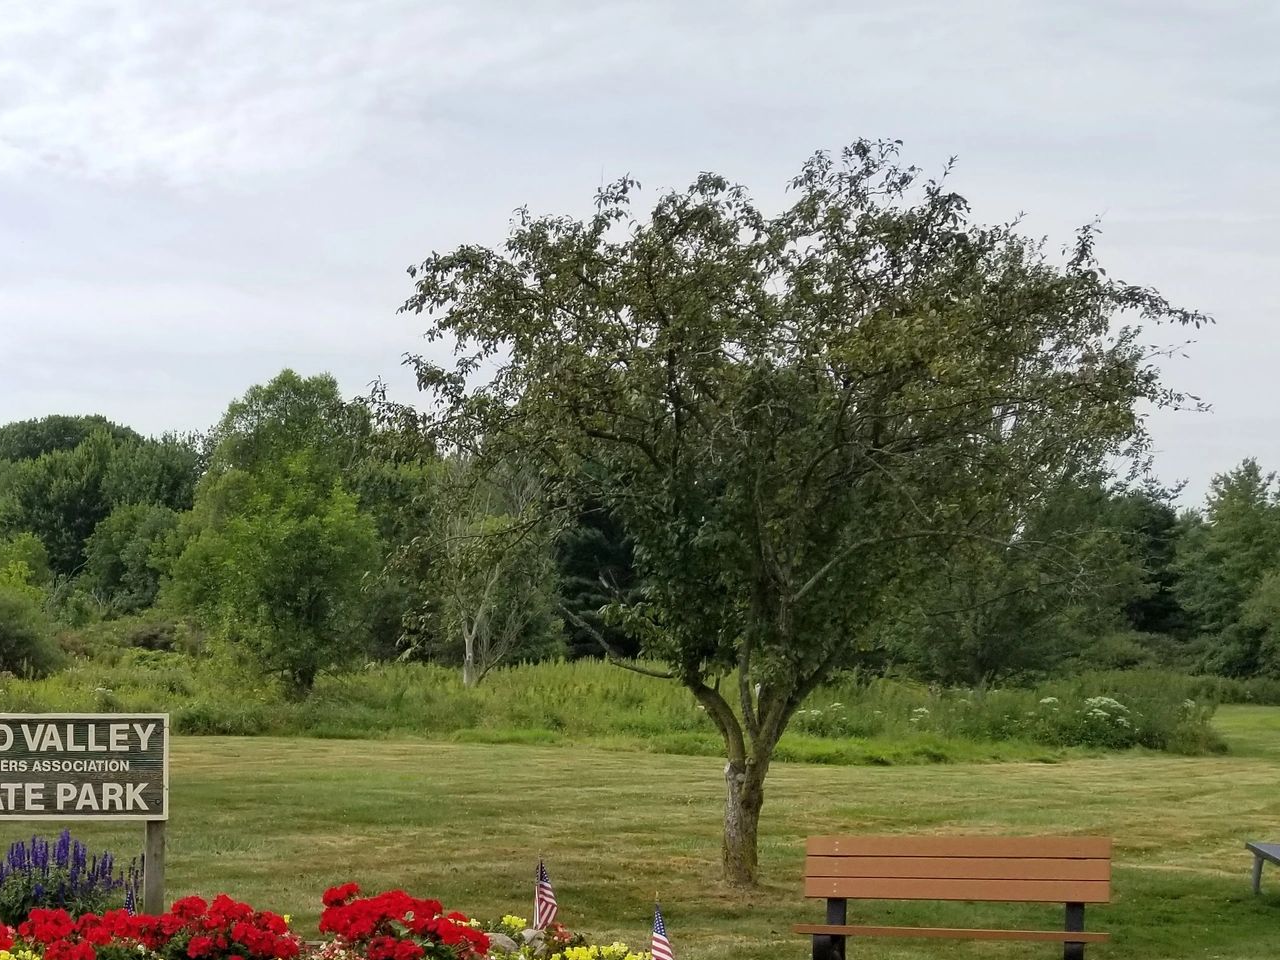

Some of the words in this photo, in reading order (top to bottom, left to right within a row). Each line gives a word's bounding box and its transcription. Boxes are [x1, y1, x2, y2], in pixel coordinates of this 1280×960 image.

[21, 723, 156, 751] VALLEY
[32, 760, 130, 772] ASSOCIATION
[56, 782, 150, 810] PARK
